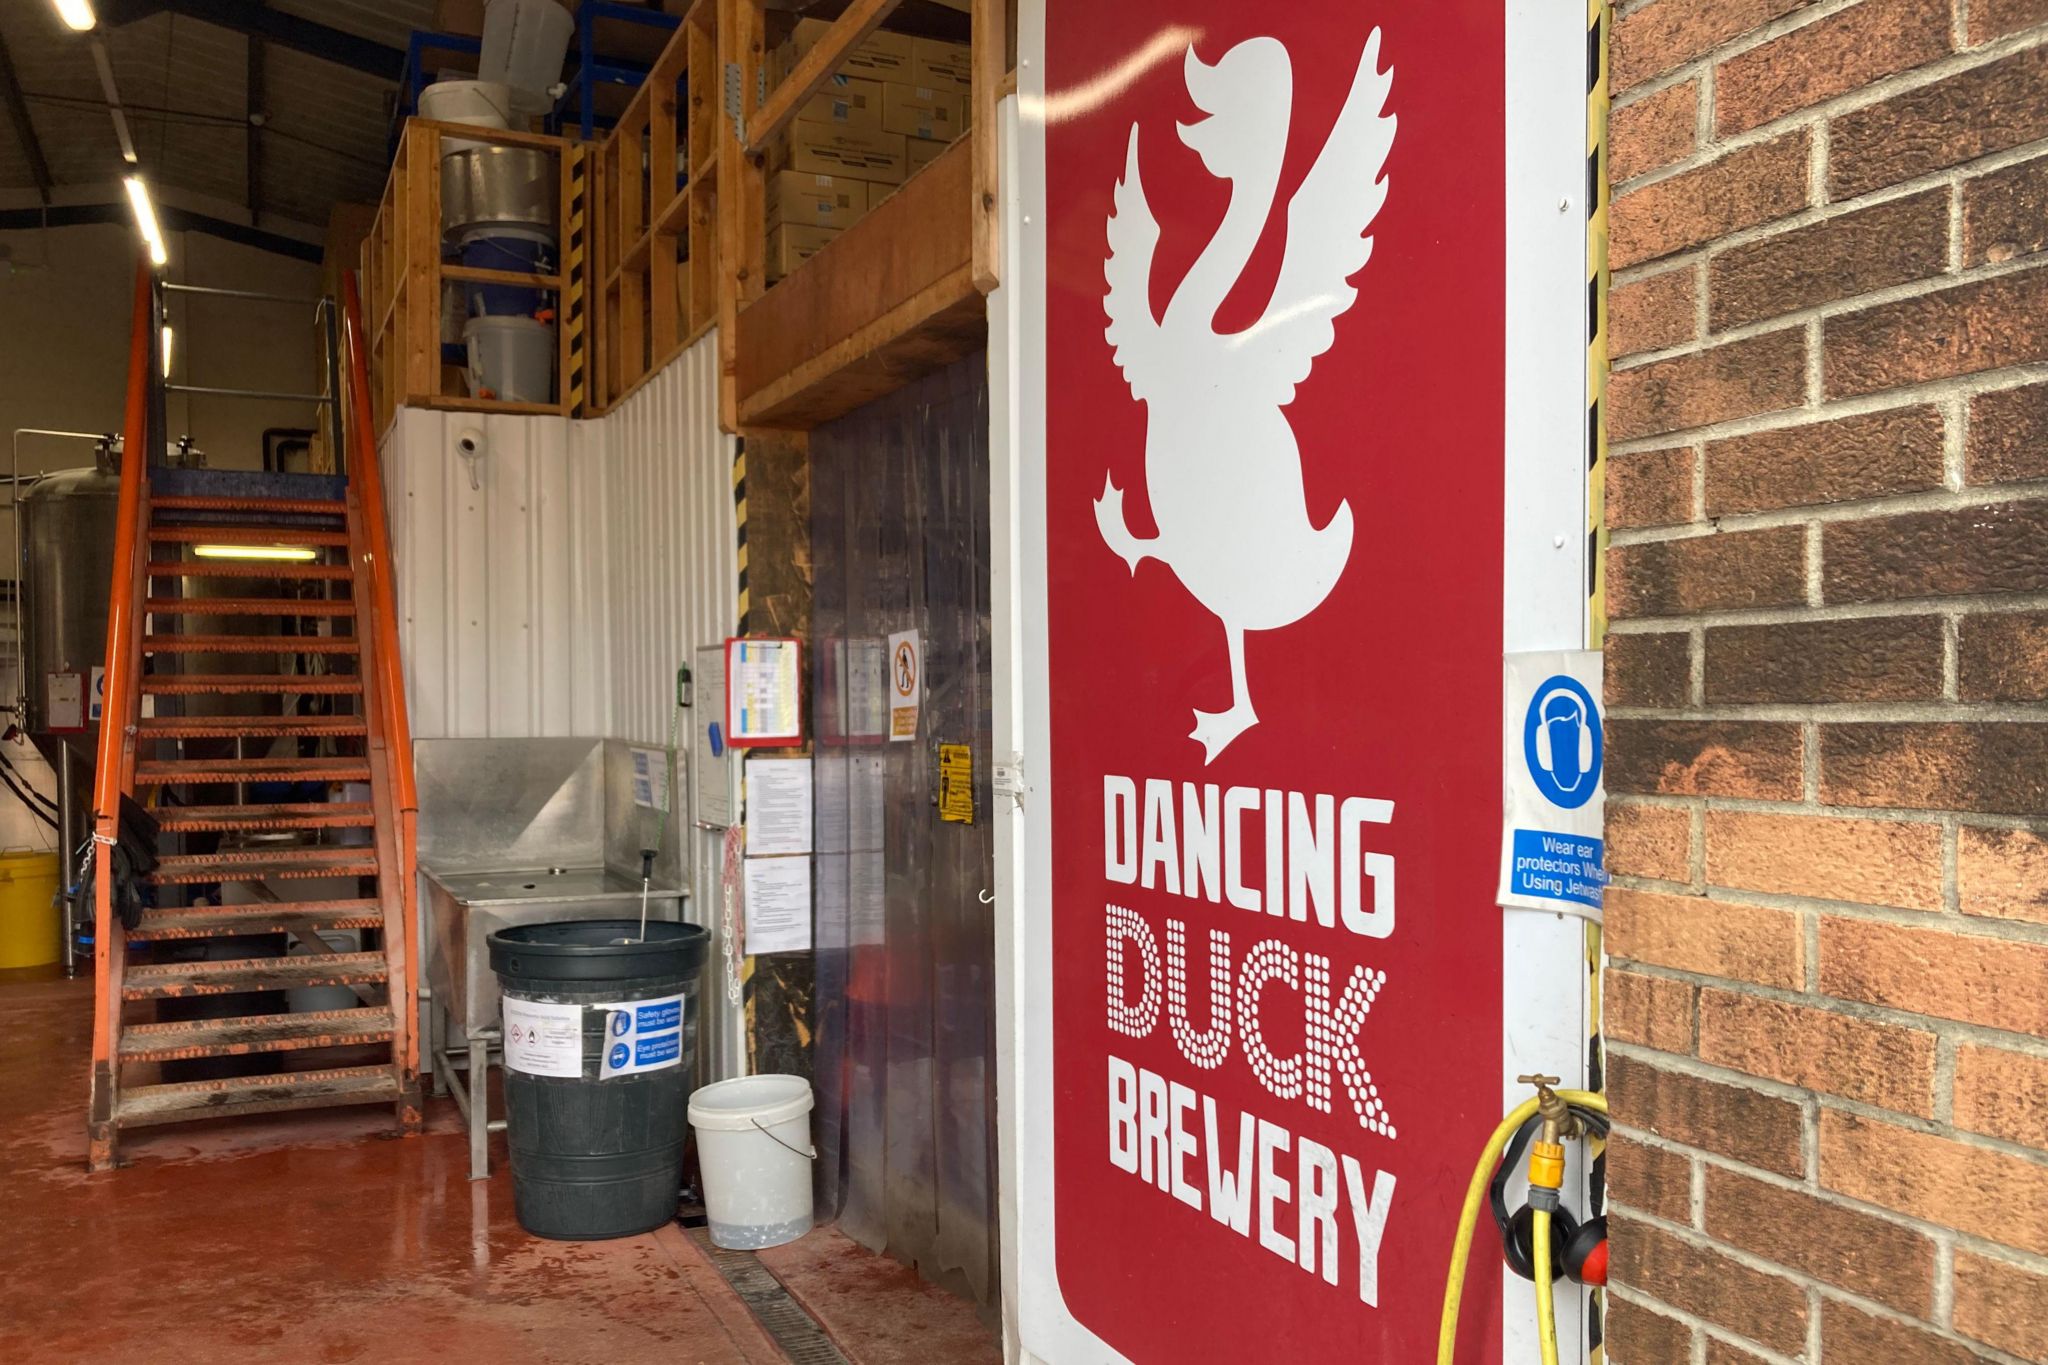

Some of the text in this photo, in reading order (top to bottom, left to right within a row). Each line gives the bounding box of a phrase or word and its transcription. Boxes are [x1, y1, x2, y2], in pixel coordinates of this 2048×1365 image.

[1104, 775, 1395, 939] DANCING
[1542, 836, 1594, 858] Wear ear
[1517, 856, 1580, 876] protectors
[1523, 872, 1562, 896] Using
[638, 1010, 660, 1020] Safety
[1106, 903, 1396, 1139] DUCK
[637, 1044, 651, 1053] Eye
[640, 1051, 656, 1059] must
[657, 1049, 665, 1057] be
[1108, 1055, 1396, 1308] BREWERY
